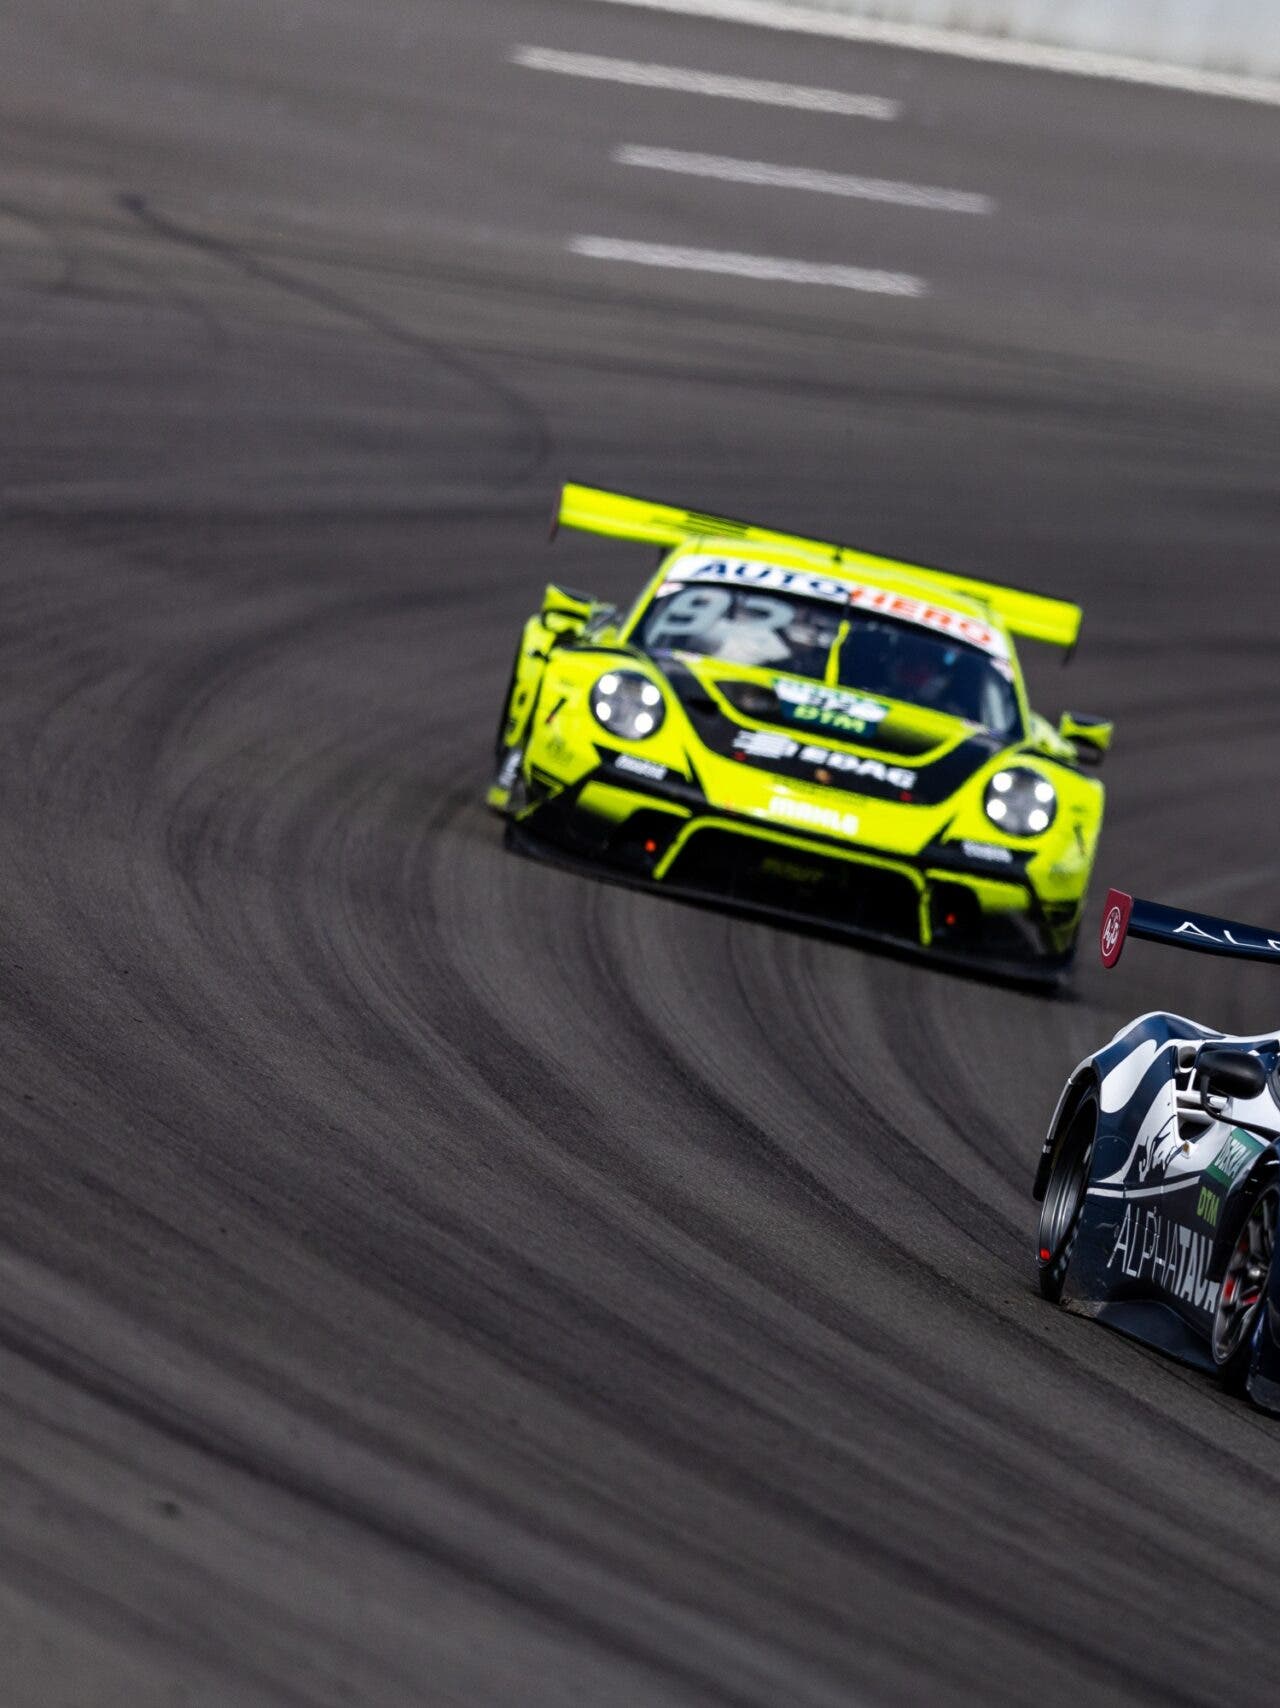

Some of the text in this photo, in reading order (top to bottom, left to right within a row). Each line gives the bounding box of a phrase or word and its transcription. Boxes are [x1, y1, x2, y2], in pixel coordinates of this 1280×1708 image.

[691, 560, 993, 646] AUTOHERO
[793, 703, 867, 733] DTM
[1197, 1186, 1220, 1227] DTM
